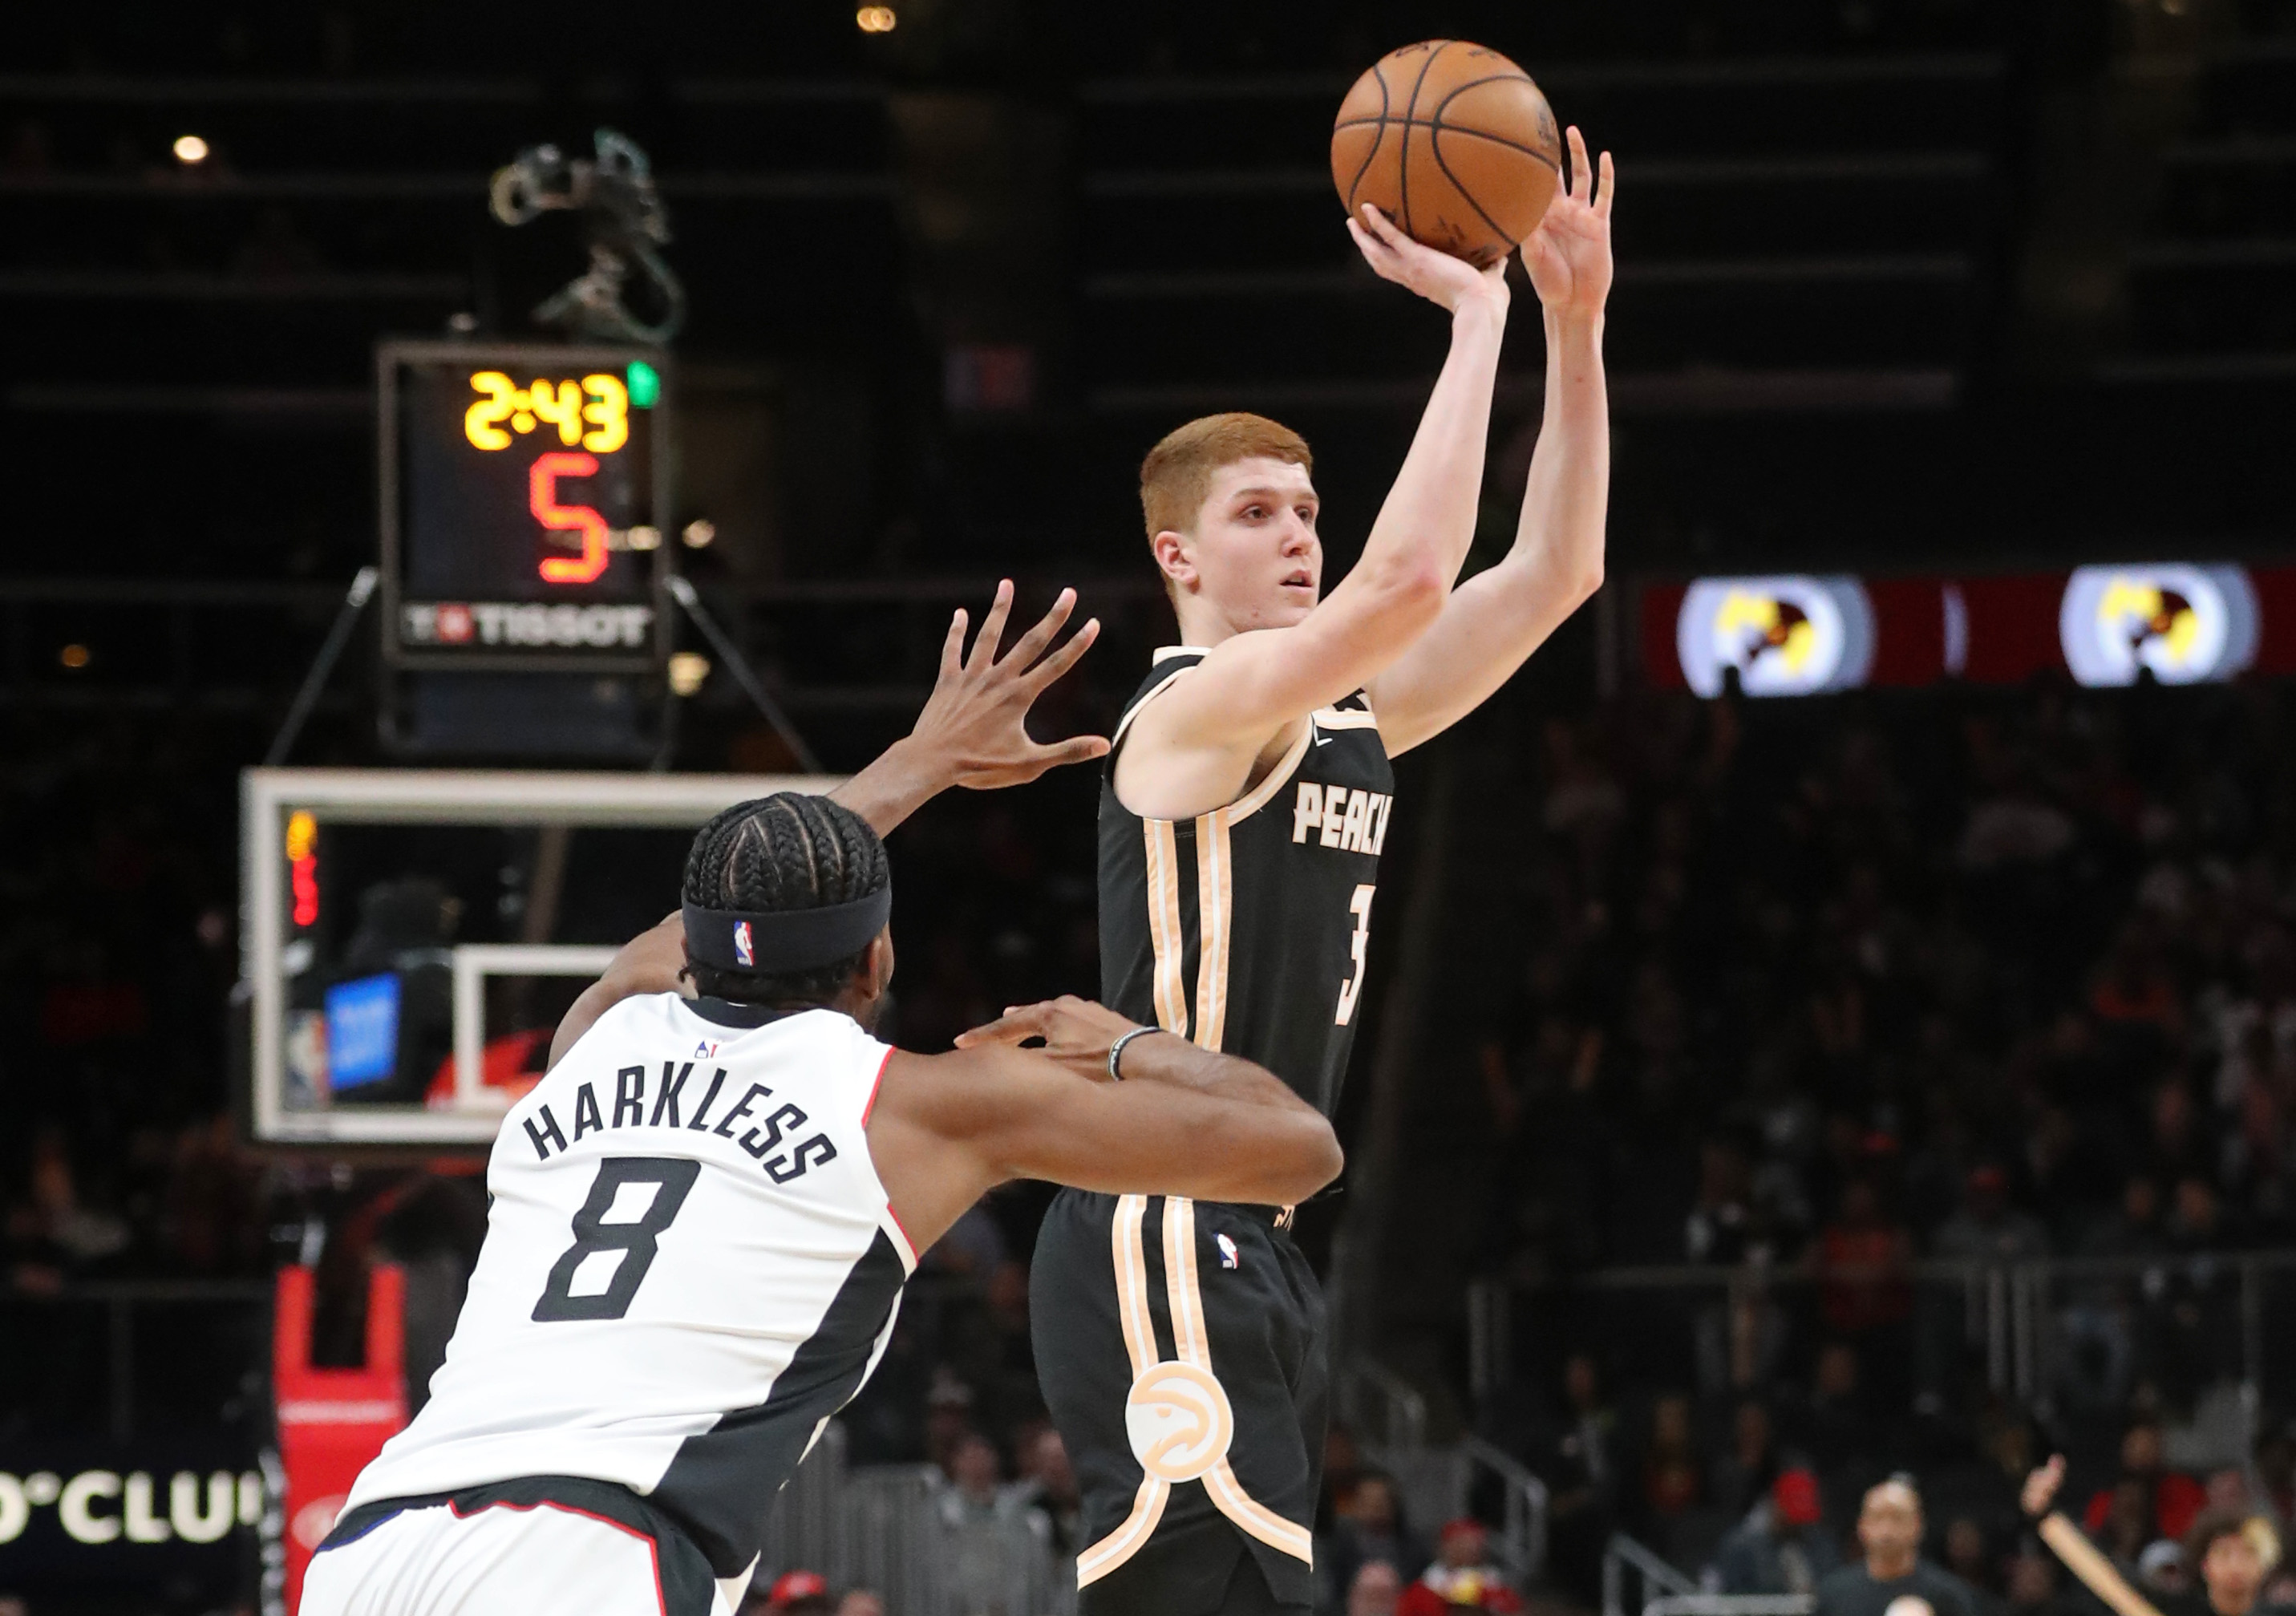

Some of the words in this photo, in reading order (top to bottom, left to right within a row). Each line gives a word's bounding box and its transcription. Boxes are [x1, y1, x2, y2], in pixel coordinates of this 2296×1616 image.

[465, 371, 629, 453] 2:43
[529, 452, 609, 583] 5
[476, 603, 653, 647] TISSOT
[1334, 884, 1376, 1026] 3
[522, 1060, 837, 1185] HARKLESS
[531, 1157, 702, 1322] 8
